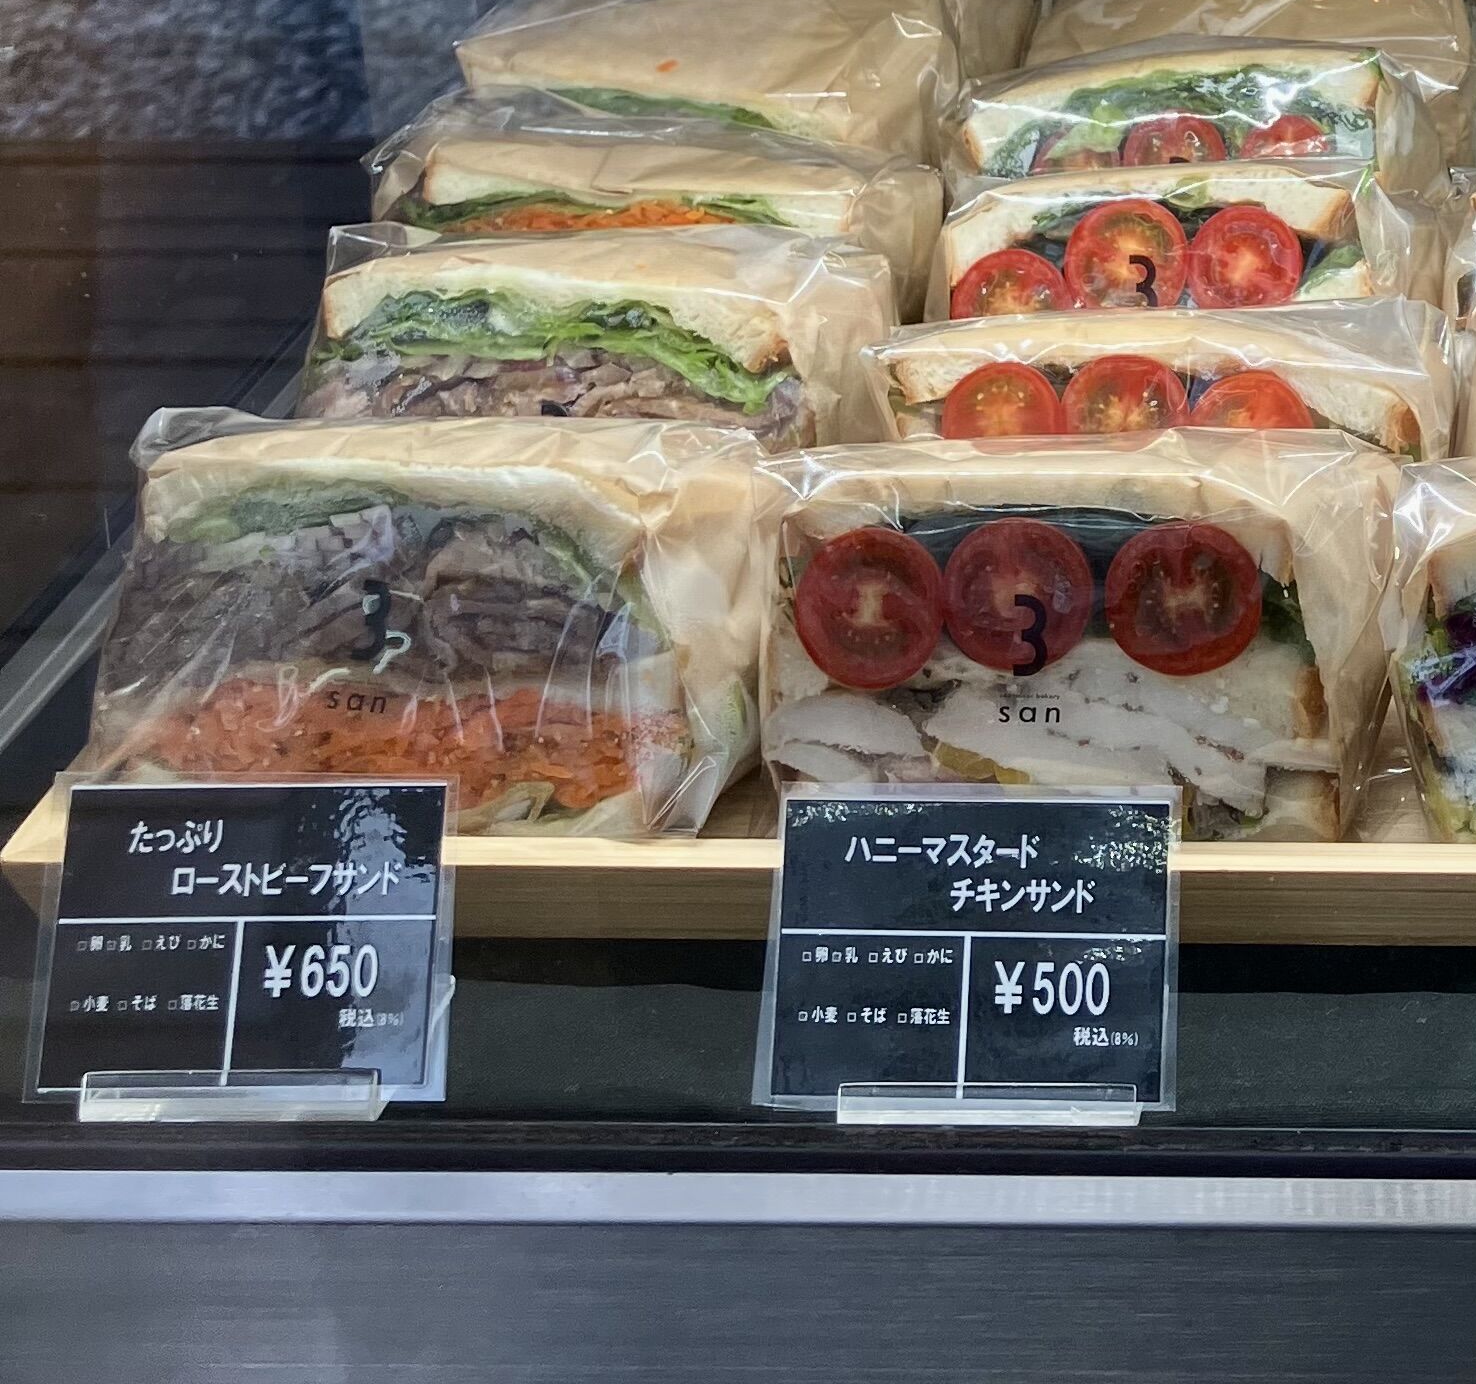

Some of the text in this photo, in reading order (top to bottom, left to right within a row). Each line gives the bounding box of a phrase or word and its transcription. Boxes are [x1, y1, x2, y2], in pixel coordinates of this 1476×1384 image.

[1013, 594, 1048, 676] 3
[327, 690, 387, 714] san
[998, 705, 1061, 724] san
[128, 819, 225, 854] たっぷり
[844, 833, 1040, 869] ハニーマスタード
[171, 861, 402, 897] ローストビーフサンド
[949, 878, 1097, 914] チキンサンド
[263, 943, 379, 998] ¥650
[994, 960, 1110, 1016] ¥500
